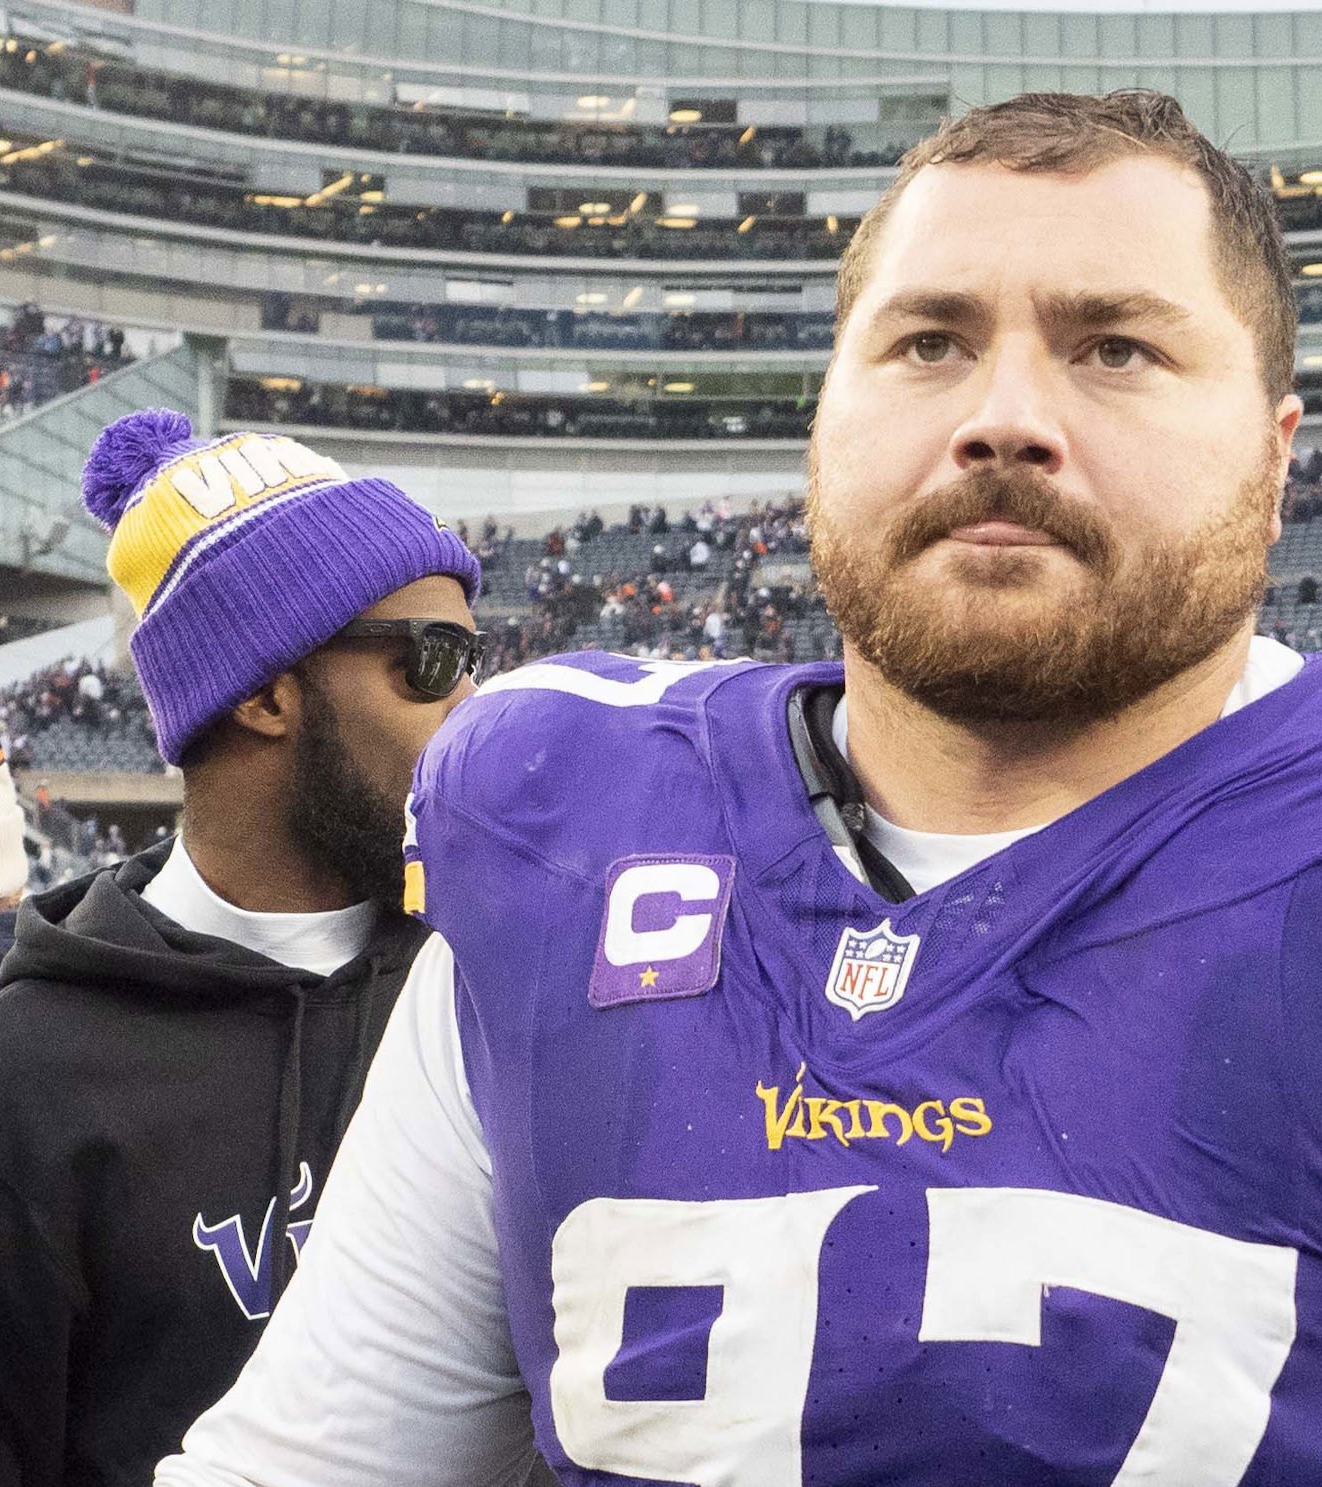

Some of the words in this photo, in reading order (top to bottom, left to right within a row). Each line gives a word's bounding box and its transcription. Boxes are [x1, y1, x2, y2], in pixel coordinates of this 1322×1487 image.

[171, 437, 346, 519] VIK
[604, 863, 721, 967] C
[842, 962, 896, 1002] NFL
